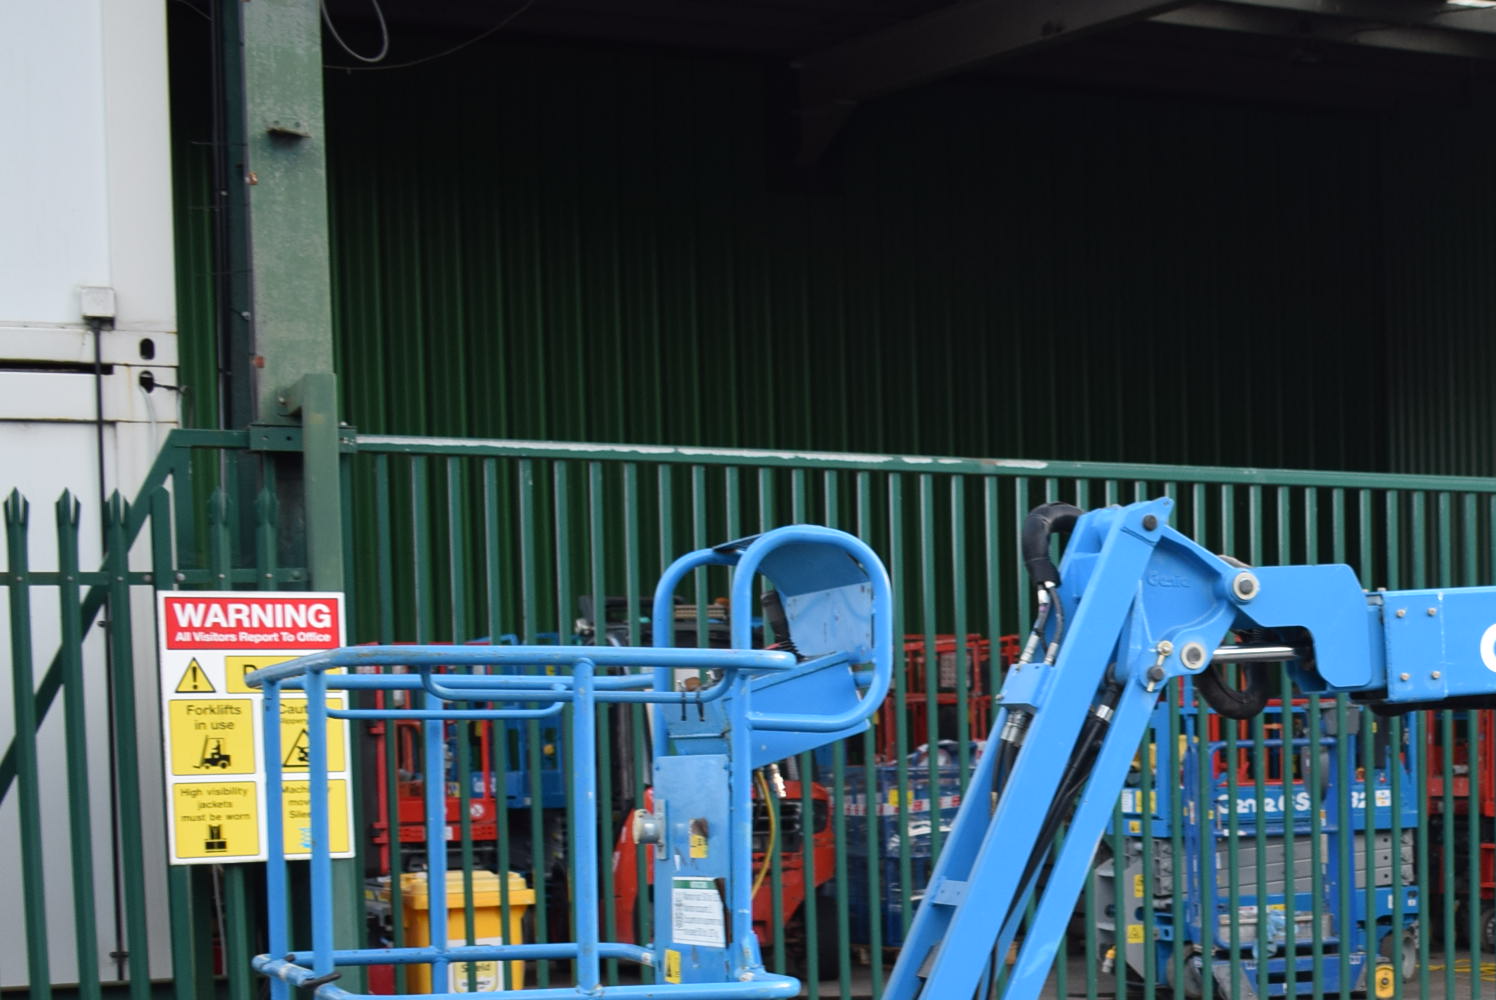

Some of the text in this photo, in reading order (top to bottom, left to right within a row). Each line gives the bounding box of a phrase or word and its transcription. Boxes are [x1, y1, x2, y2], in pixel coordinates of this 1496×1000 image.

[172, 602, 332, 629] WARNING
[175, 631, 332, 644] All Visitors Report To Office
[186, 704, 243, 716] Forklifts
[194, 719, 235, 730] in use
[180, 787, 248, 798] High visibility
[197, 801, 233, 811] jackets
[181, 813, 251, 822] must be worn
